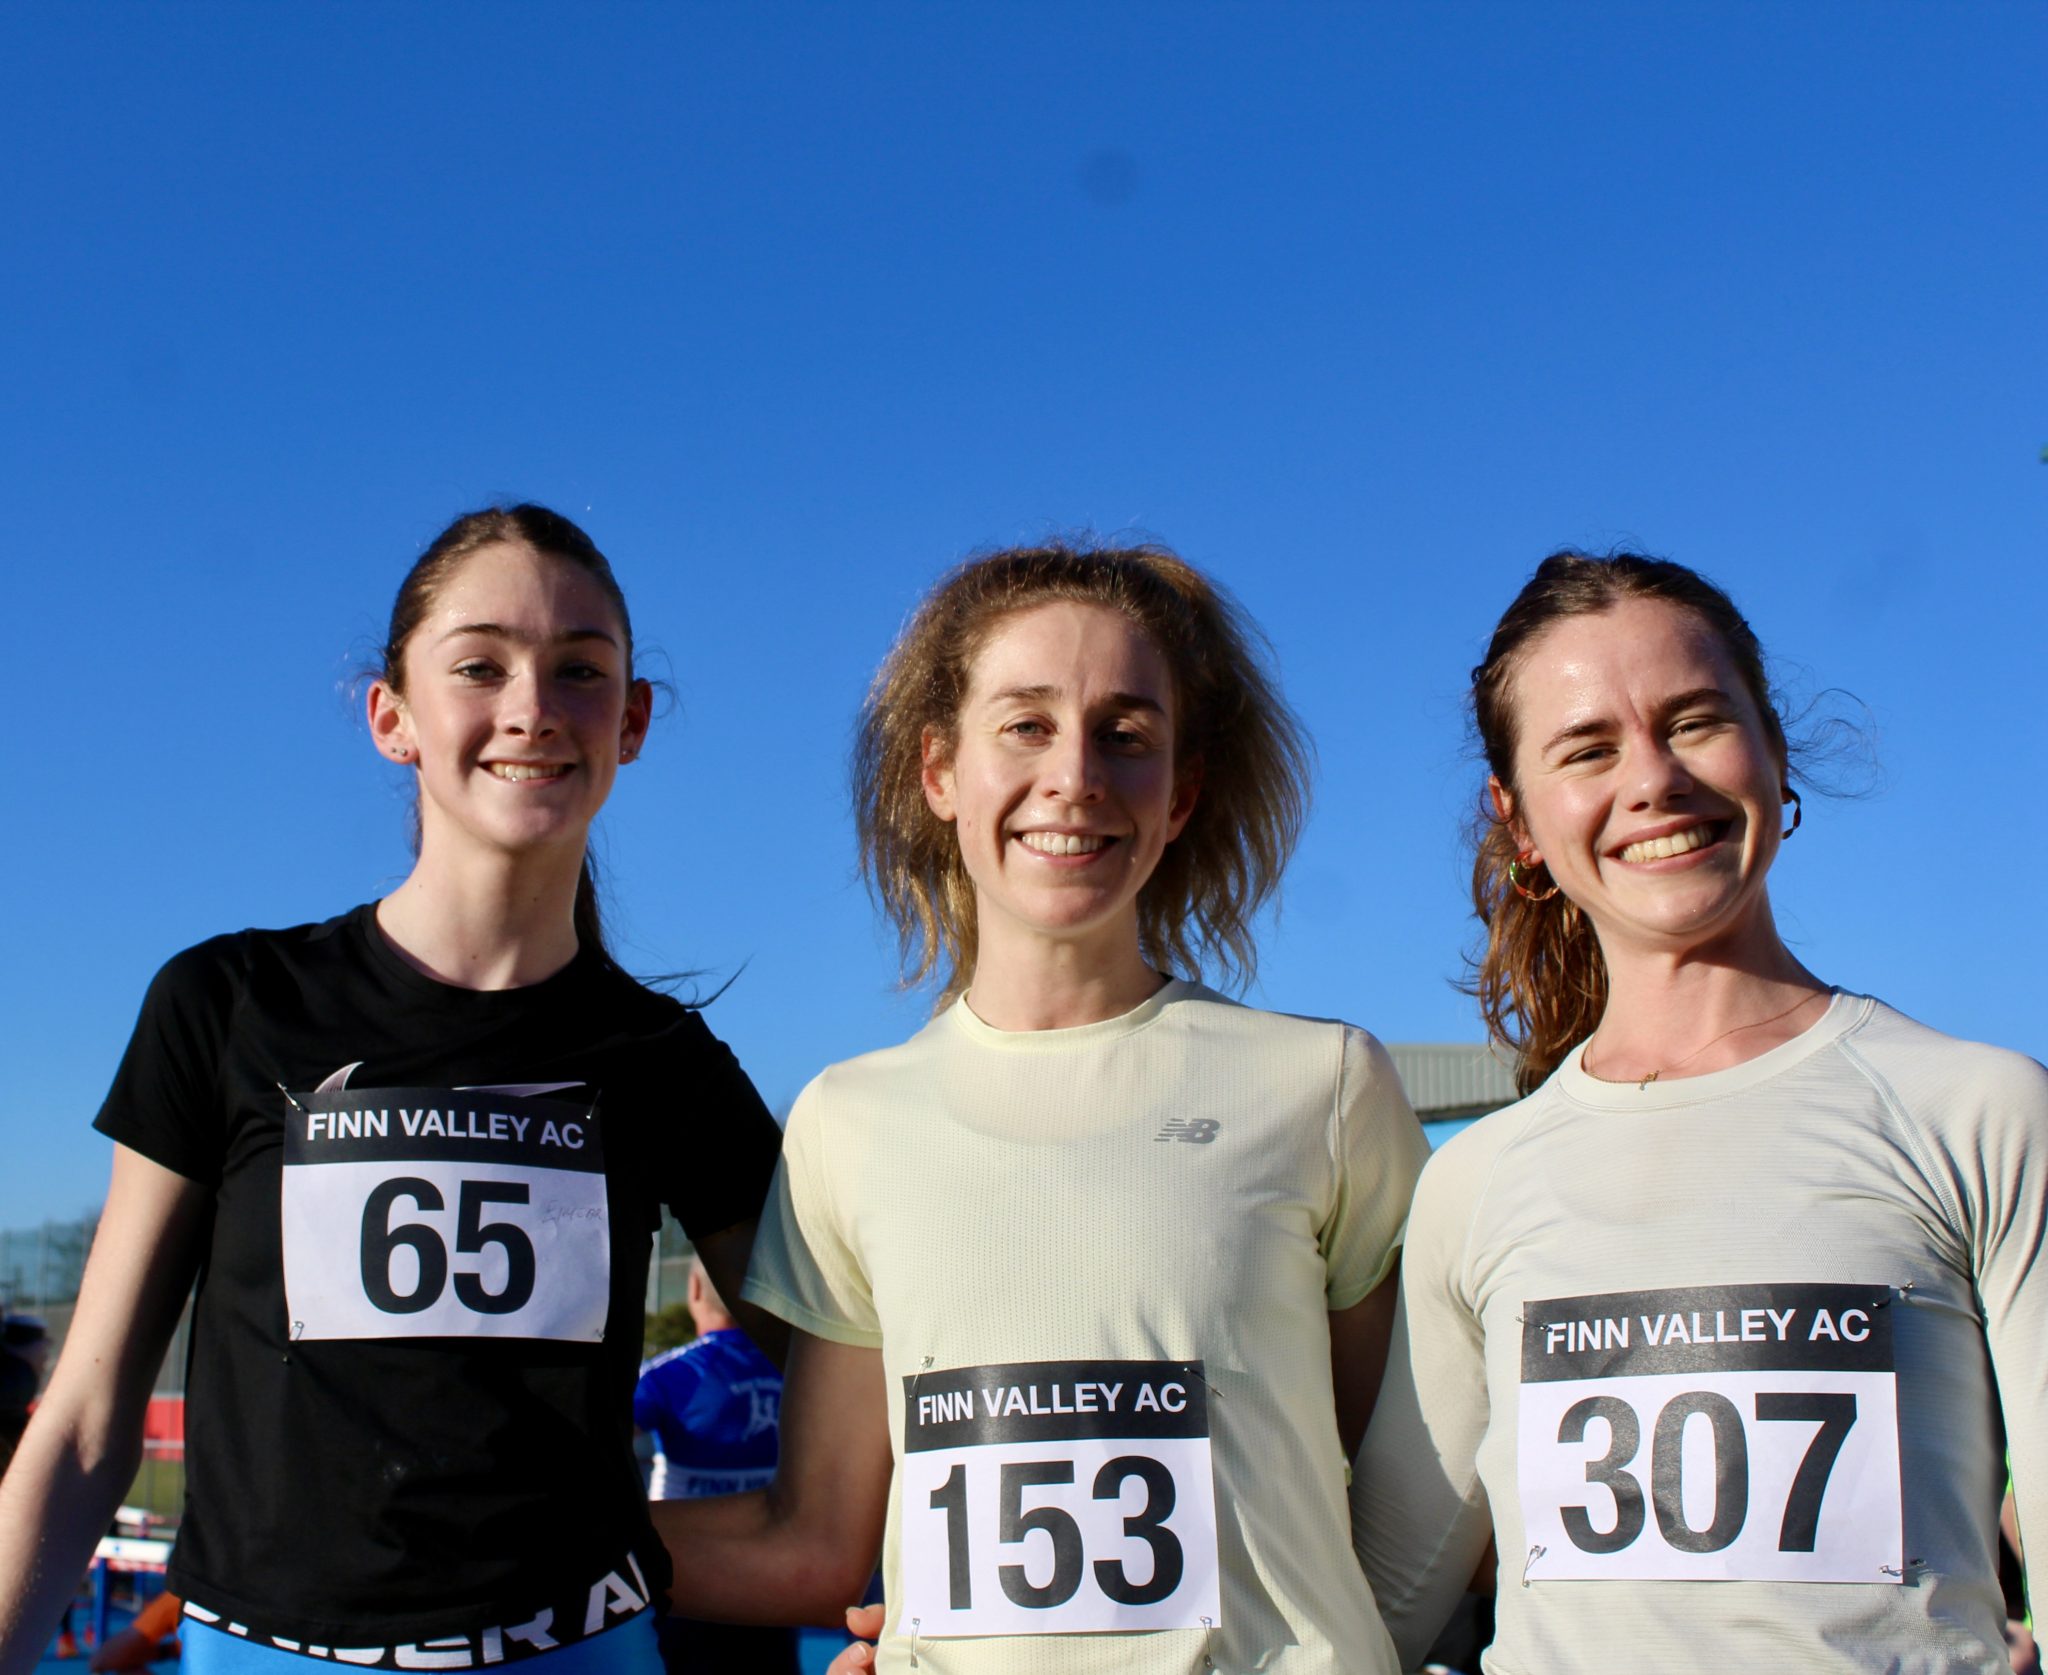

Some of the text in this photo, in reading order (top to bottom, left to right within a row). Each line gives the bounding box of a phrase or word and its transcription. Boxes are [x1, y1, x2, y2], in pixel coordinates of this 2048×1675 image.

[307, 1109, 585, 1150] FINN VALLEY AC
[360, 1176, 536, 1315] 65
[1546, 1308, 1871, 1354] FINN VALLEY AC
[918, 1382, 1188, 1426] FINN VALLEY AC
[1557, 1391, 1858, 1554] 307
[929, 1455, 1184, 1609] 153
